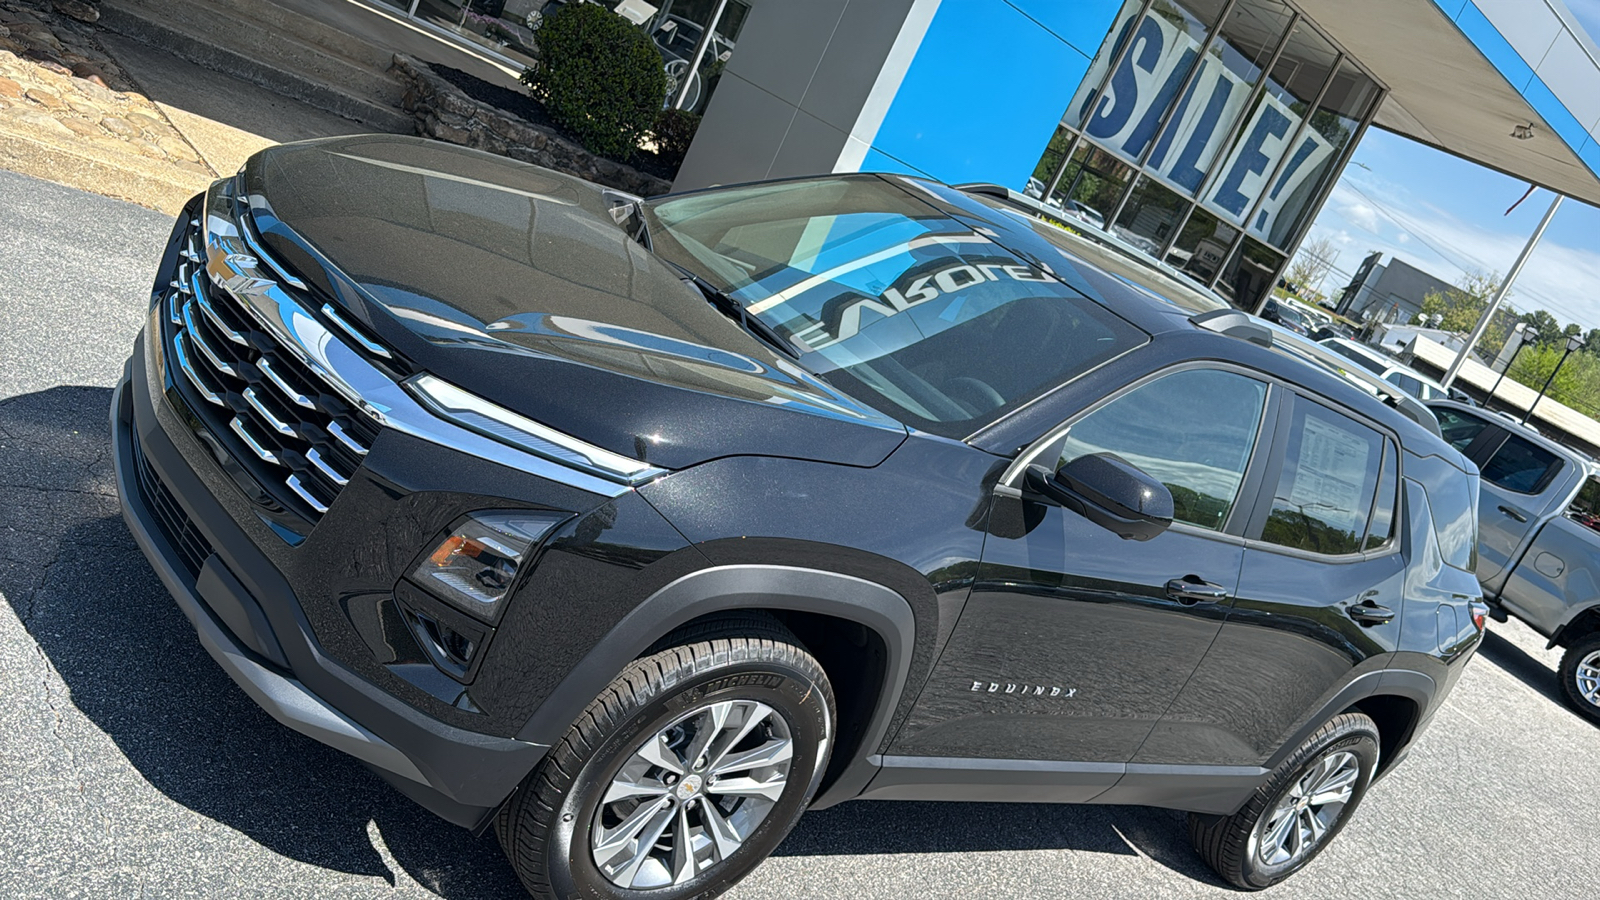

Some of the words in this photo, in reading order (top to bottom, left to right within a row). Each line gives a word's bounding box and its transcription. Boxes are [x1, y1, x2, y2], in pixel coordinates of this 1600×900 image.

[1080, 13, 1319, 233] SALE!
[706, 674, 781, 693] MICHELIN
[970, 681, 1077, 698] EQUINOX
